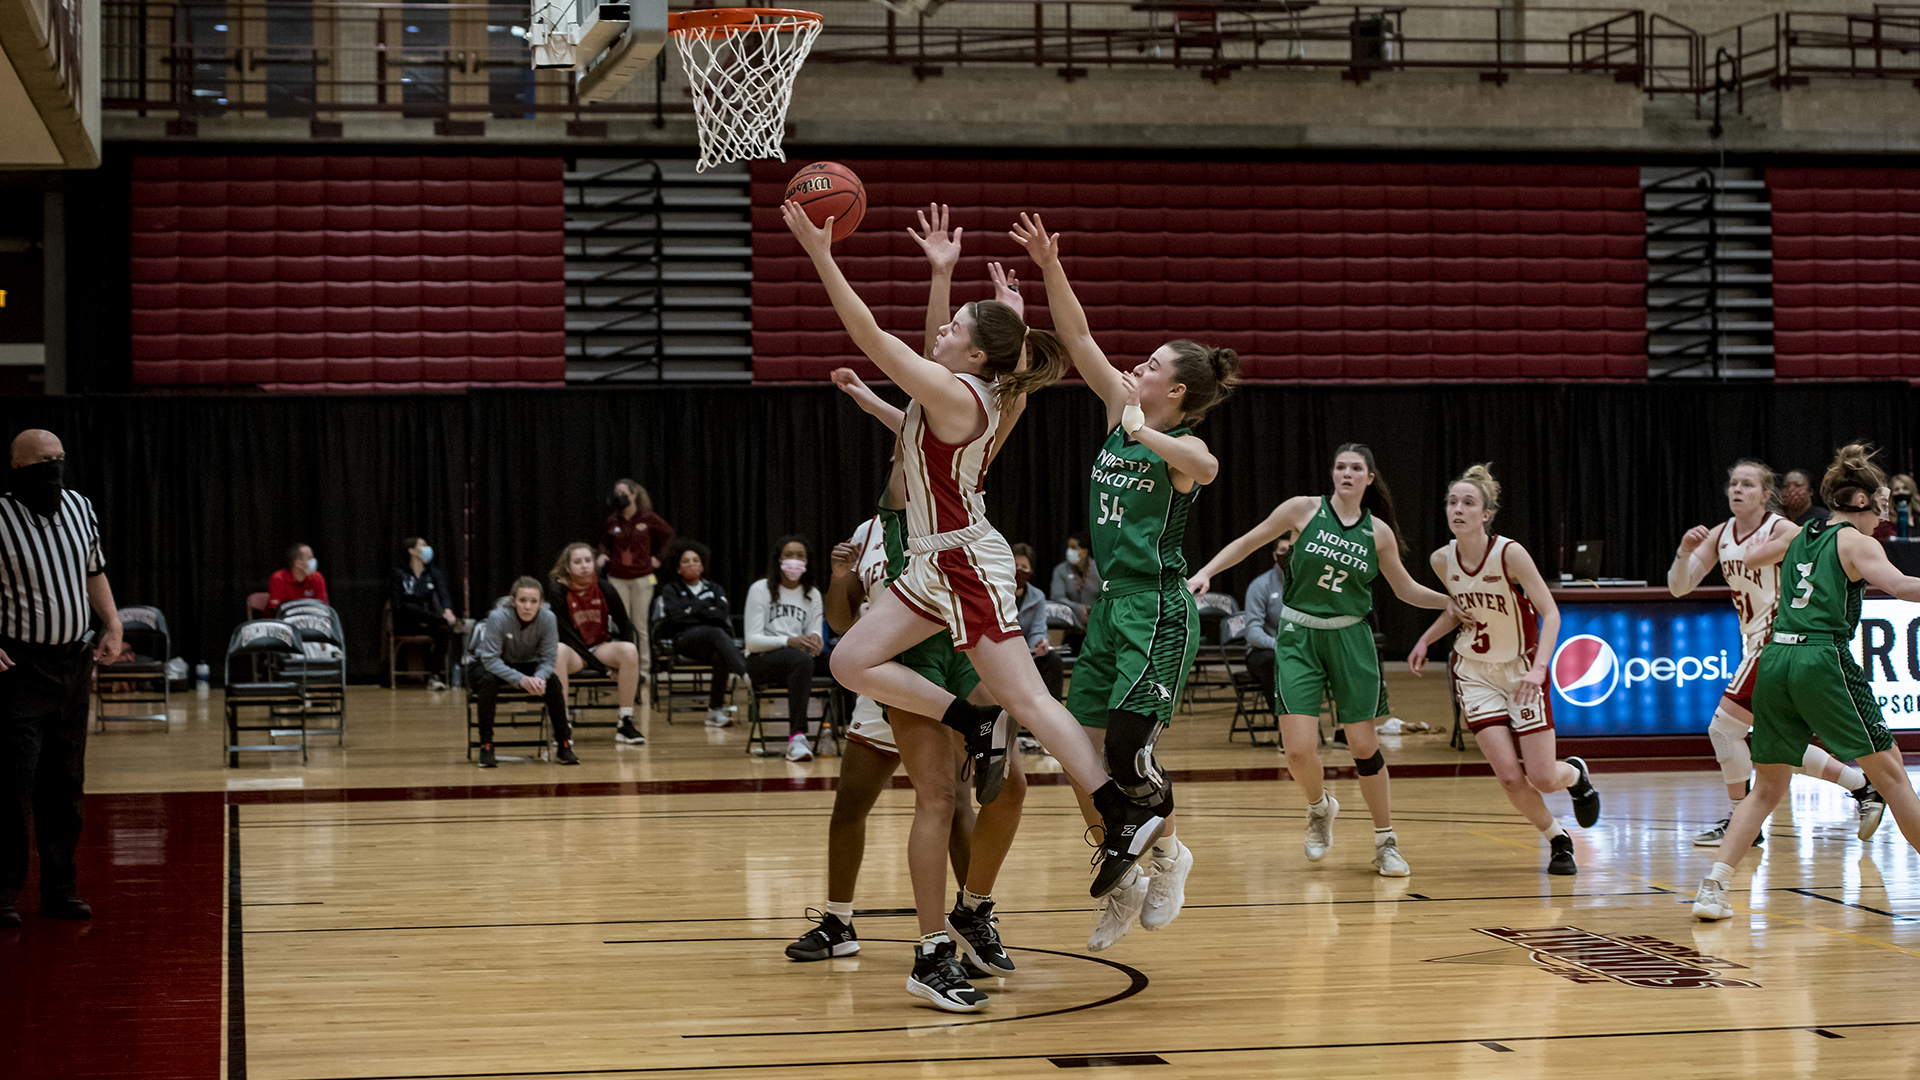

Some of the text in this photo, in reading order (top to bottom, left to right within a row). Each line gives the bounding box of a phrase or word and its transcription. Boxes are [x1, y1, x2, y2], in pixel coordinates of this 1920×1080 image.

[1097, 448, 1151, 473] NORTH
[1097, 492, 1124, 528] 54
[1304, 542, 1369, 573] DAKOTA
[1316, 529, 1368, 557] NORTH
[1317, 564, 1349, 593] 22
[1721, 560, 1763, 589] ENVER
[1790, 562, 1814, 609] 3
[1455, 592, 1509, 616] ENVER
[1471, 621, 1491, 654] 5
